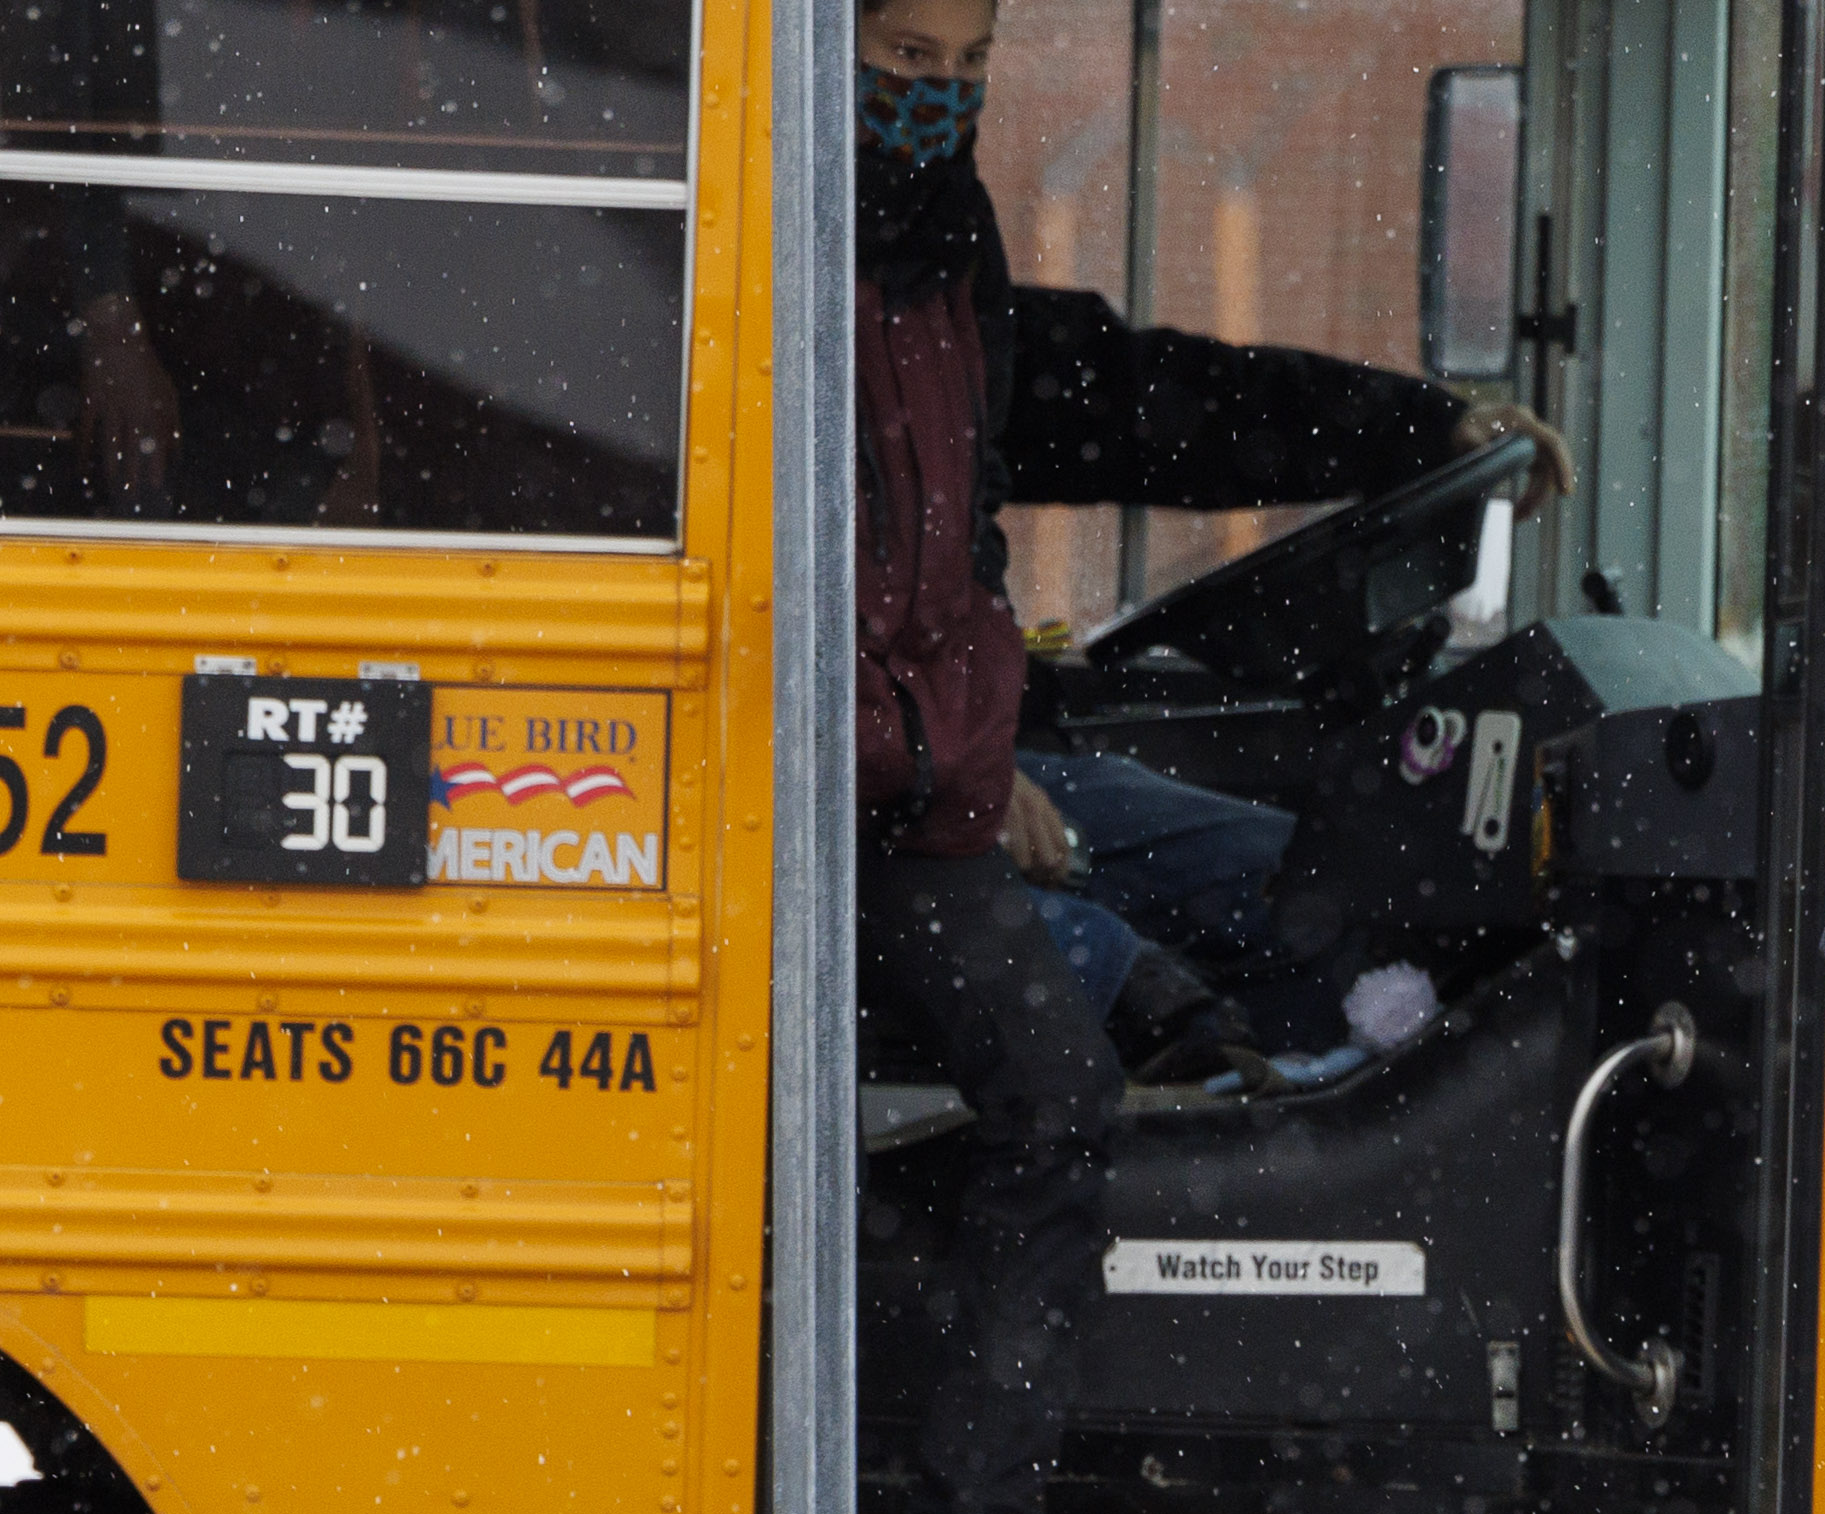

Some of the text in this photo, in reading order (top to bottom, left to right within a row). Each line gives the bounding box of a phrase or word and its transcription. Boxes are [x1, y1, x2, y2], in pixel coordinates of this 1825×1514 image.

[247, 697, 367, 743] RT#
[526, 716, 638, 755] BIRD
[281, 754, 386, 853] 30
[426, 827, 658, 885] MERICAN
[159, 1018, 658, 1093] SEATS 66C 44A
[1156, 1254, 1379, 1285] Watch Your Step
